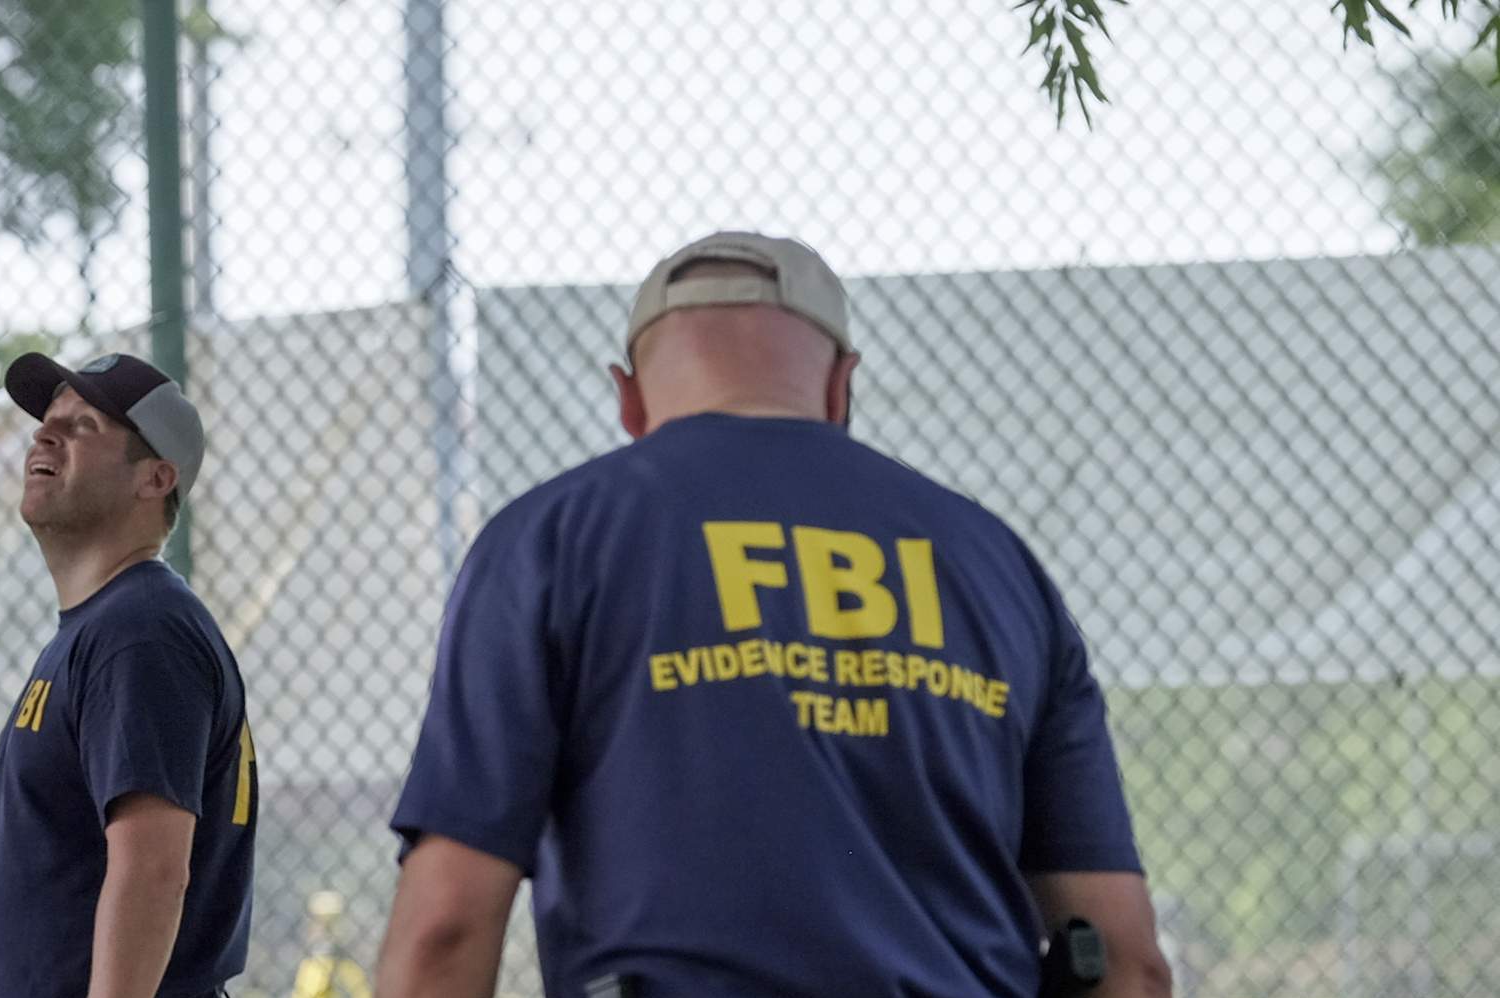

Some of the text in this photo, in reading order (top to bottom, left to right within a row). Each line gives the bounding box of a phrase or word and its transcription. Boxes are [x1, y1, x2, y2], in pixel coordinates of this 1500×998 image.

[703, 521, 944, 649] FBI
[14, 679, 52, 732] BI
[650, 639, 1010, 718] EVIDENCE RESPONSE
[790, 691, 890, 736] TEAM
